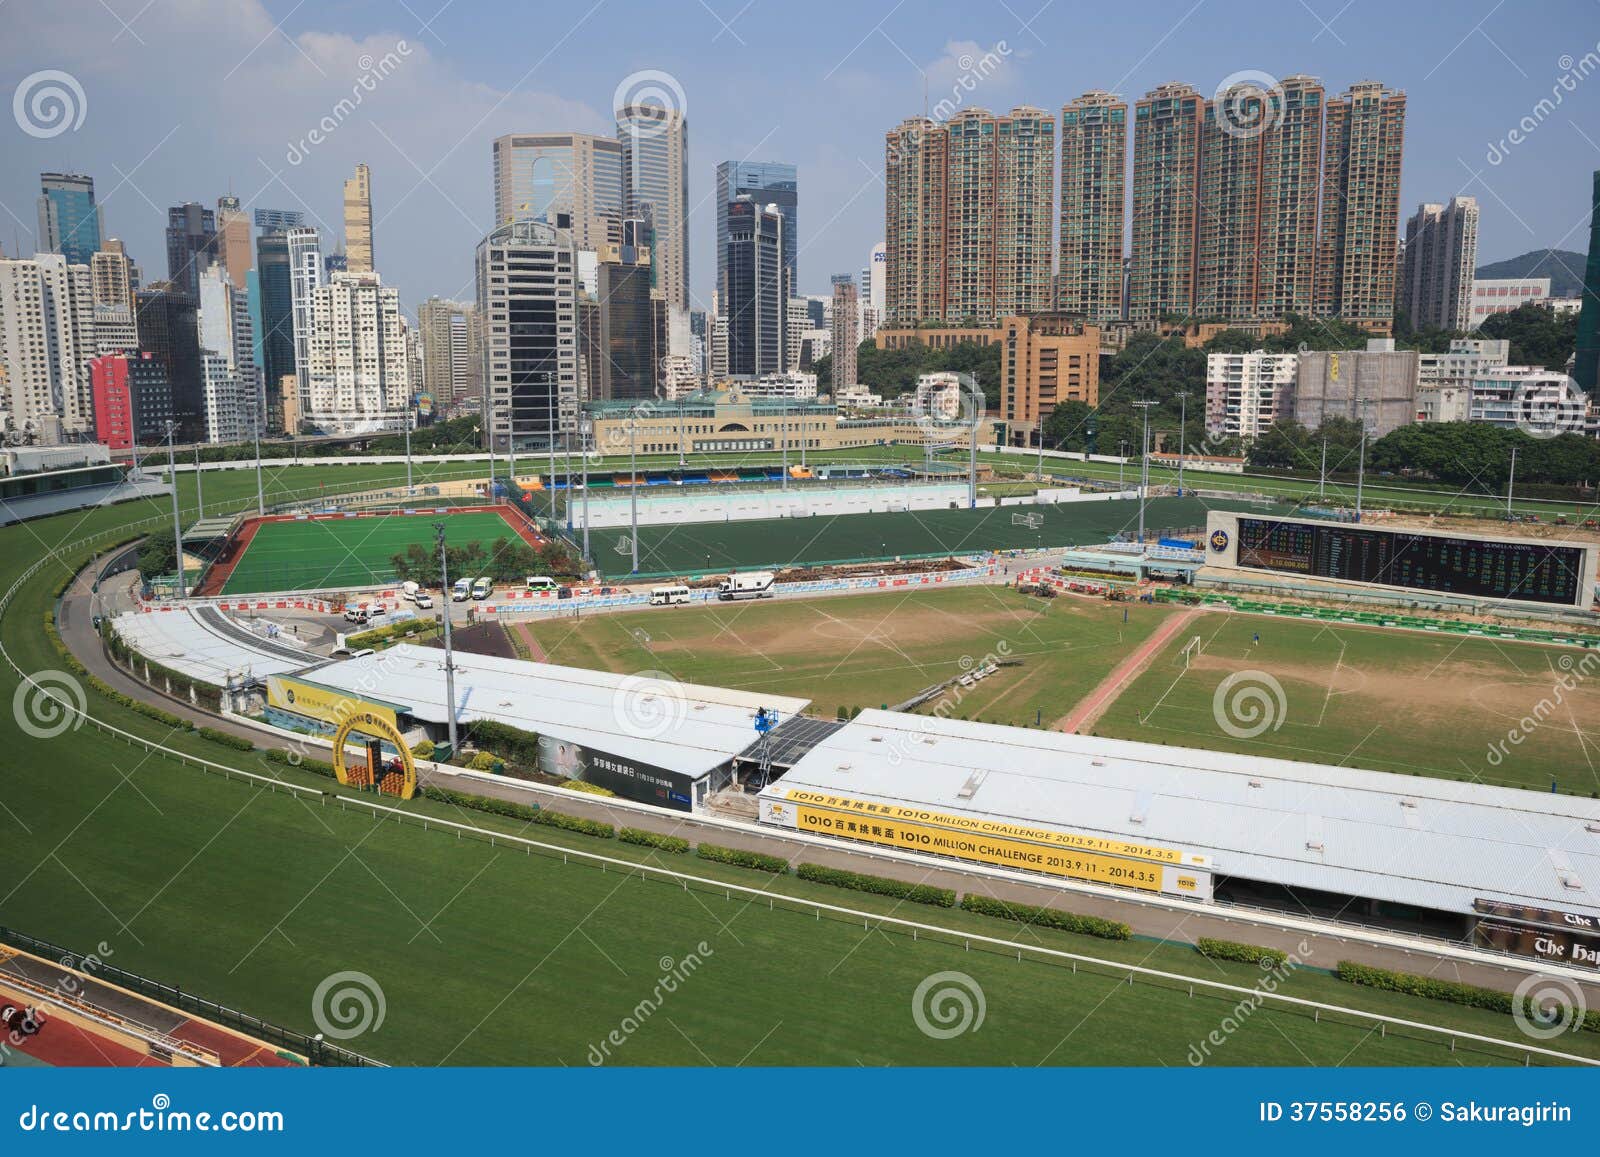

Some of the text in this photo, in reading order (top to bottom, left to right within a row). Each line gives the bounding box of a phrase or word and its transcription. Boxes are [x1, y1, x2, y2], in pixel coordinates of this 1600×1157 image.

[793, 791, 825, 802] 1010
[897, 808, 930, 820] 1010
[932, 815, 980, 828] MILLION
[982, 823, 1053, 840] CHALLENGE
[1055, 834, 1110, 849] 2013.9.11
[1123, 845, 1174, 859] 2014.3.5
[803, 814, 832, 827] 1010
[835, 819, 895, 839] 百萬挑戰盃
[900, 831, 931, 845] 1010
[933, 837, 976, 853] MILLION
[978, 845, 1043, 864] CHALLENGE
[1108, 867, 1156, 883] 2014.3.5
[1562, 913, 1592, 927] The
[1534, 937, 1565, 956] The
